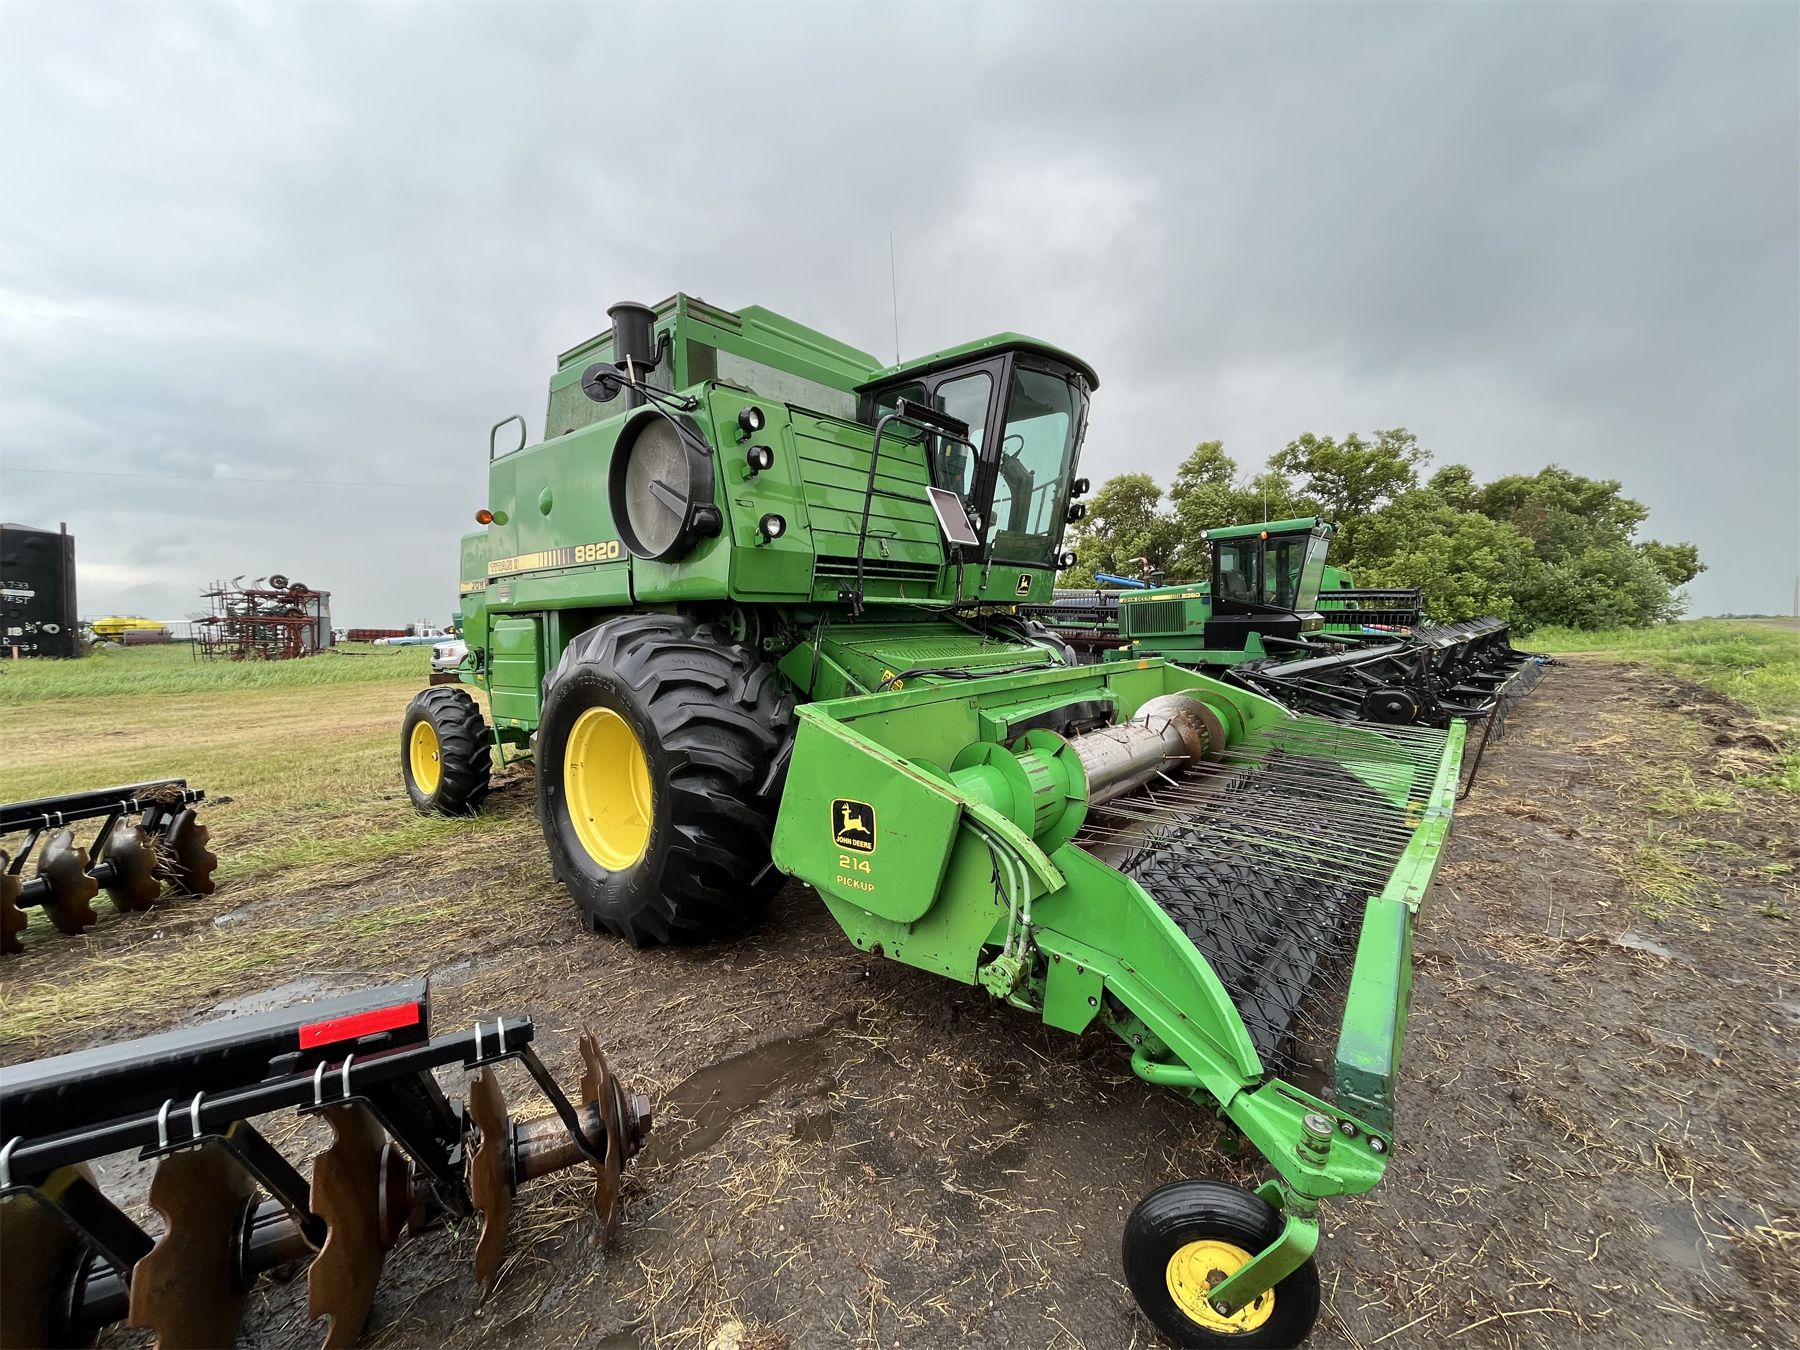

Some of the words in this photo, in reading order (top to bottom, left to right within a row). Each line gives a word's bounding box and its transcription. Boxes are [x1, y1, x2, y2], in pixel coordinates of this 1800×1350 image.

[574, 540, 620, 563] 8820
[836, 836, 852, 846] JOHN
[852, 840, 873, 850] DEERE
[839, 854, 872, 874] 214
[837, 875, 875, 892] PICKUP
